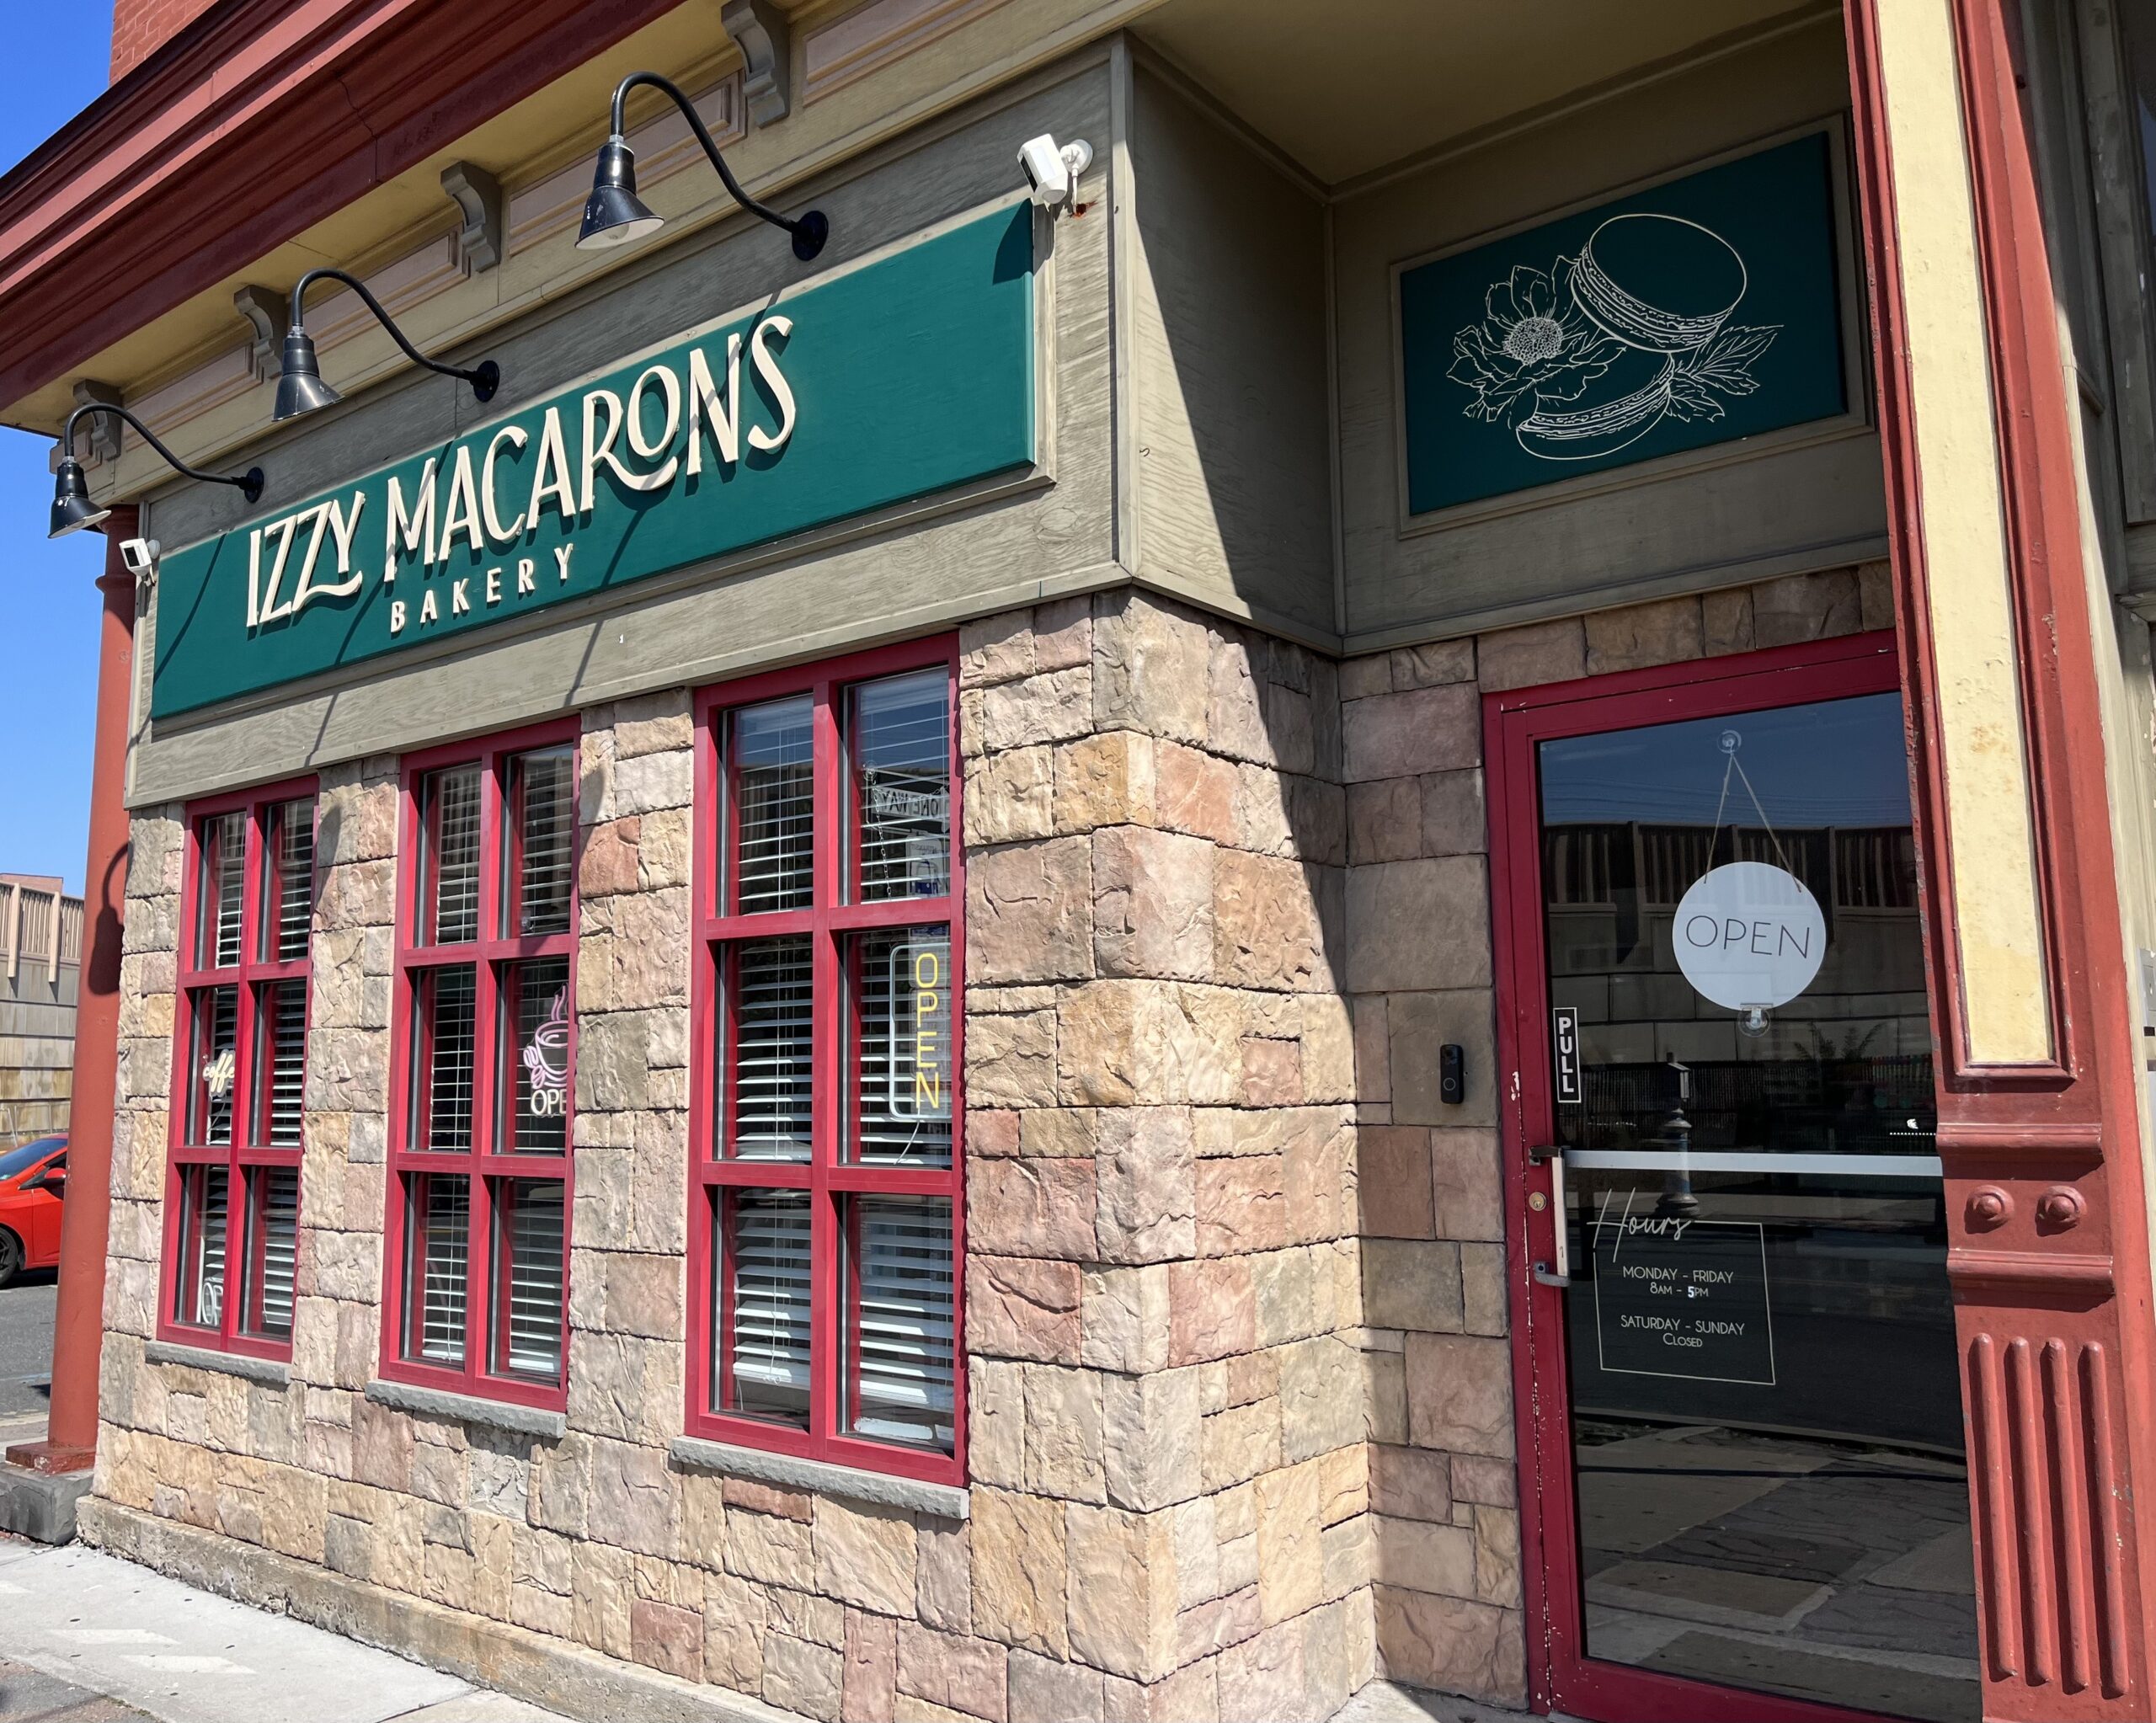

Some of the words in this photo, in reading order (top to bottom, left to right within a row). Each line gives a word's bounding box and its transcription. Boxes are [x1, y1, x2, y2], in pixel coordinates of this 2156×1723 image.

[246, 491, 366, 627] IZZY
[383, 316, 796, 583] MACARONS
[390, 543, 574, 632] BAKERY
[1686, 915, 1810, 959] OPEN
[915, 952, 939, 1109] OPEN
[203, 1053, 235, 1093] coffe
[1558, 1016, 1575, 1093] PULL
[531, 1089, 567, 1116] OPE
[1586, 1187, 1692, 1263] Hours
[1622, 1266, 1678, 1281] MONDAY
[1693, 1270, 1734, 1283] FRIDAY
[1650, 1282, 1673, 1294] 8AM
[1687, 1286, 1709, 1299] 5PM
[1620, 1315, 1681, 1331] SATURDAY
[1694, 1320, 1745, 1336] SUNDAY
